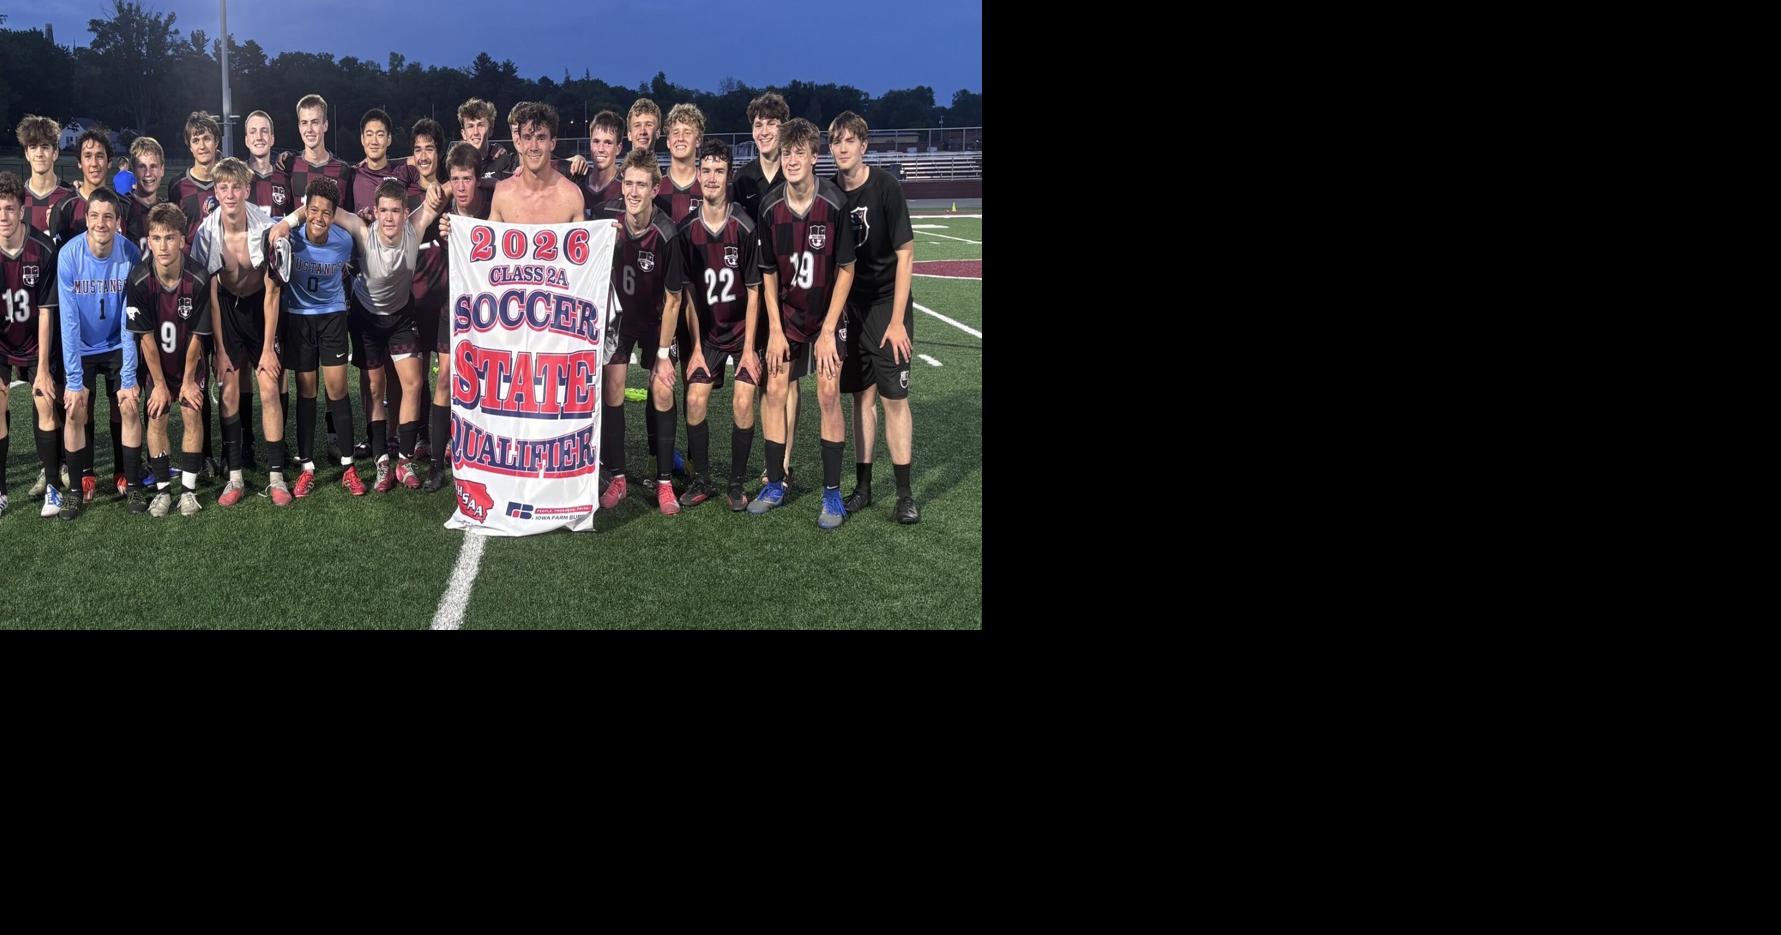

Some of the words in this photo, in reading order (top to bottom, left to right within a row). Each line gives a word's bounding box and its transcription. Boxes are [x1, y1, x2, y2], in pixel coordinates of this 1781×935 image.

[470, 225, 590, 265] 2026
[489, 264, 545, 287] CLASS
[545, 267, 569, 290] 2A
[622, 265, 636, 296] 6
[704, 267, 736, 306] 22
[789, 251, 815, 290] 19
[2, 287, 30, 324] 13
[99, 298, 107, 320] 1
[453, 288, 600, 346] SOCCER
[161, 321, 177, 353] 9
[452, 339, 597, 420] STATE
[450, 409, 597, 479] QUALIFIER
